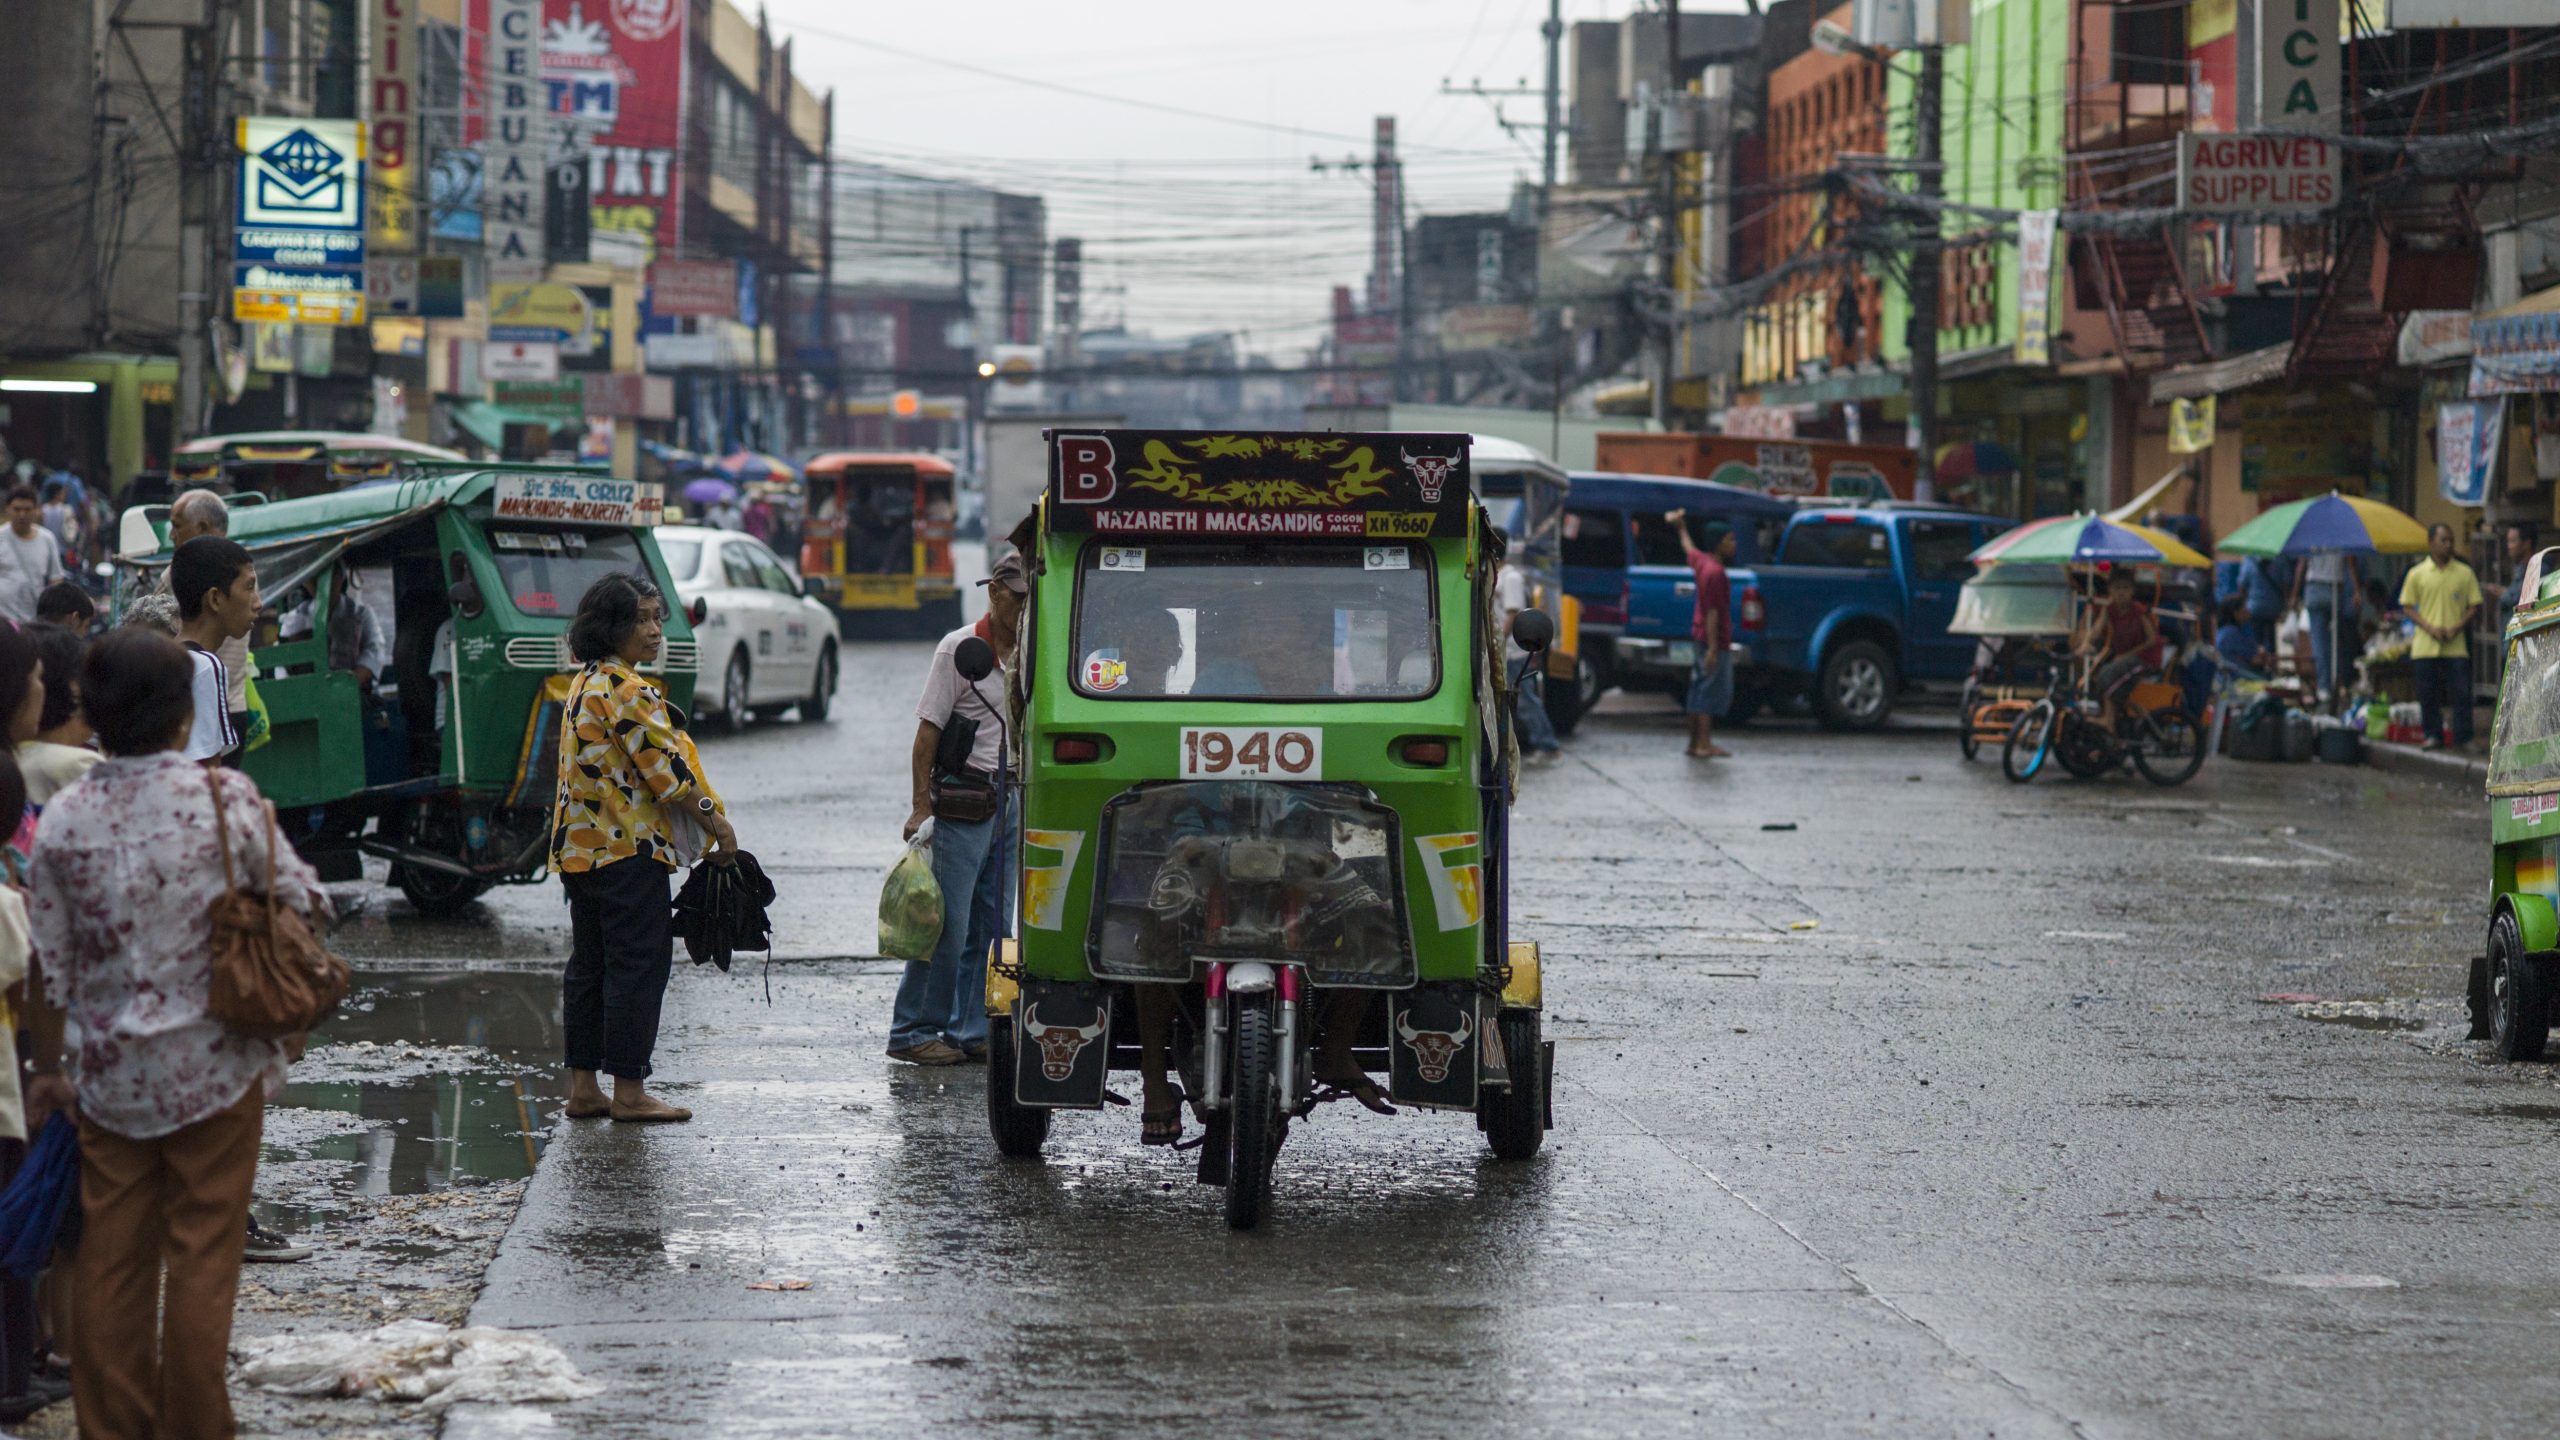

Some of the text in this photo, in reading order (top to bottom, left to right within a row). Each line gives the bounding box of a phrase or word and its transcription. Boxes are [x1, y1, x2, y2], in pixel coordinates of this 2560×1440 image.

[2192, 137, 2328, 170] AGRIVET
[2191, 173, 2332, 204] SUPPLIES
[1057, 435, 1116, 503] B
[586, 483, 634, 503] CRUZ
[1096, 511, 1364, 532] NAZARETH MACASANDIG COGON
[1329, 524, 1361, 533] MKT.
[1369, 517, 1429, 533] XH 9660
[1184, 731, 1314, 774] 1940
